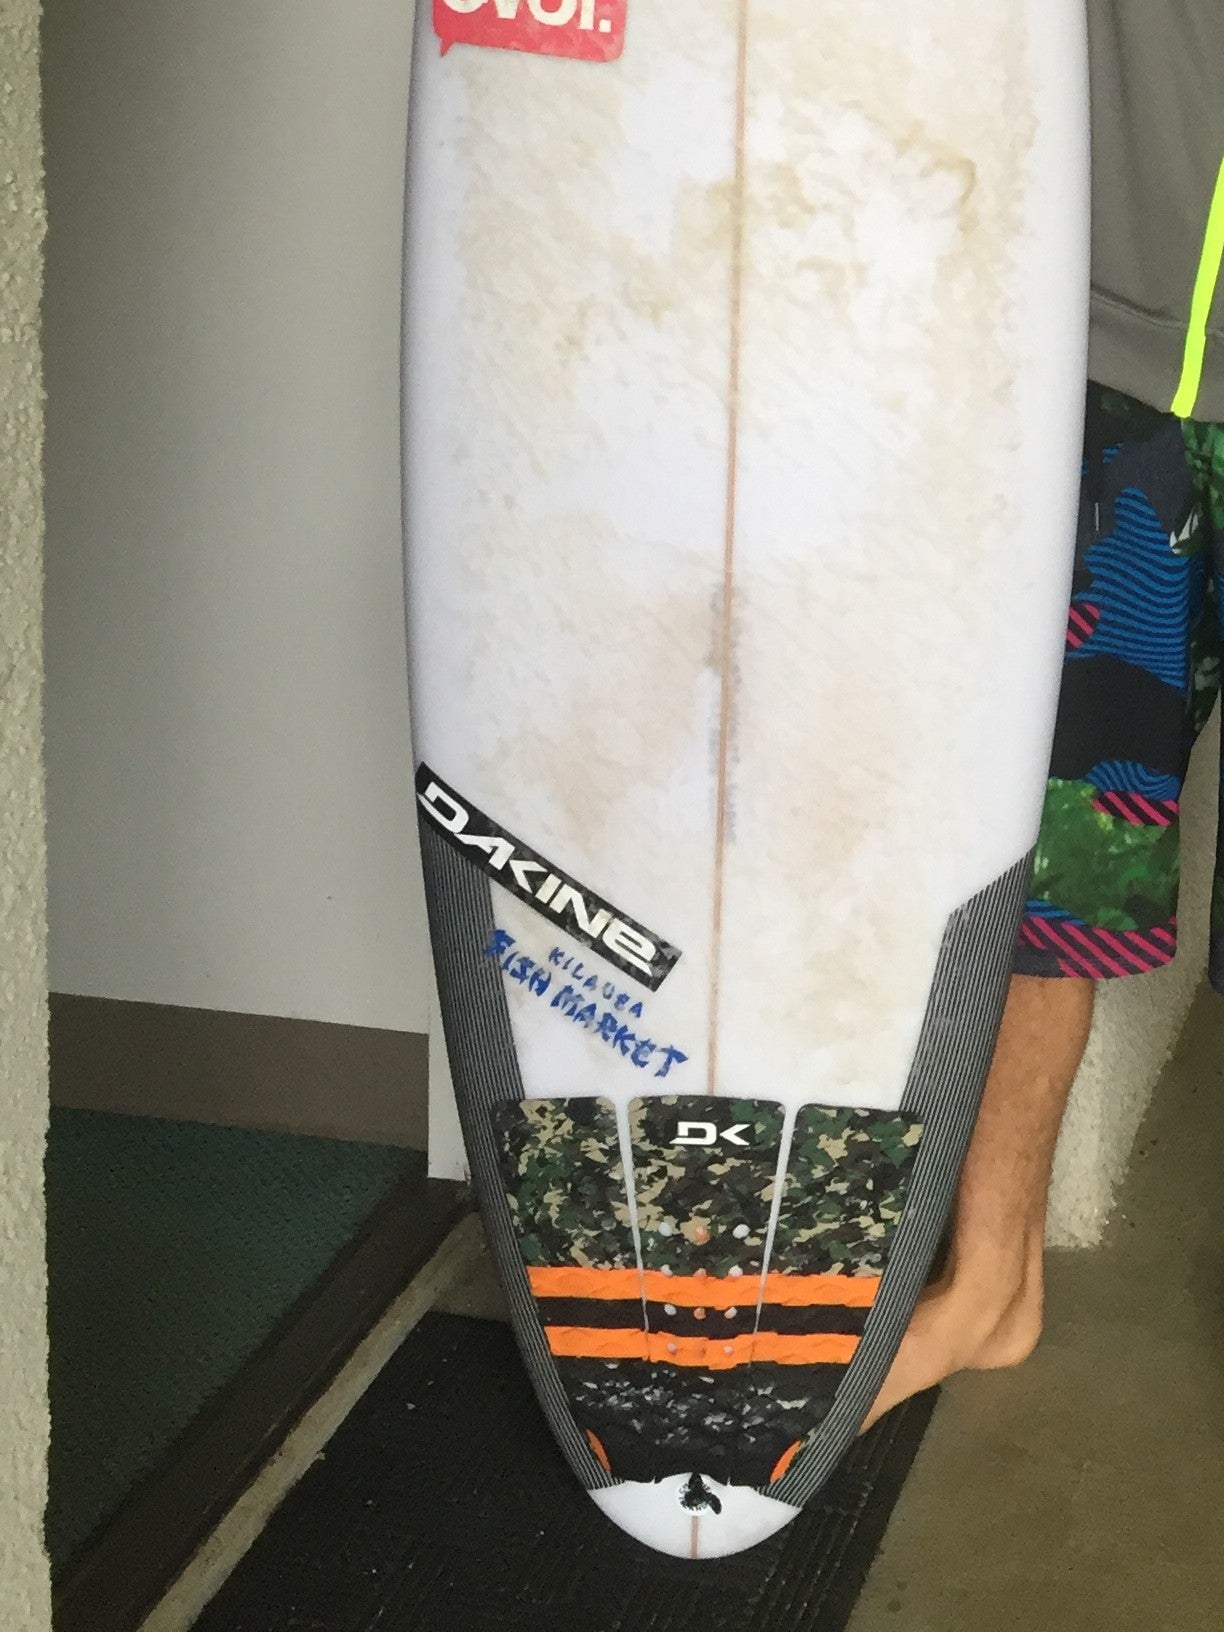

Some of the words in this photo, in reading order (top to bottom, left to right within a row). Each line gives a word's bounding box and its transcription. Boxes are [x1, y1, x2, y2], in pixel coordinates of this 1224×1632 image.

[417, 781, 657, 976] DAKINE
[484, 929, 552, 997] FISH
[550, 984, 689, 1077] MARKET
[548, 946, 643, 1018] KILAUEA
[669, 1121, 752, 1146] DK
